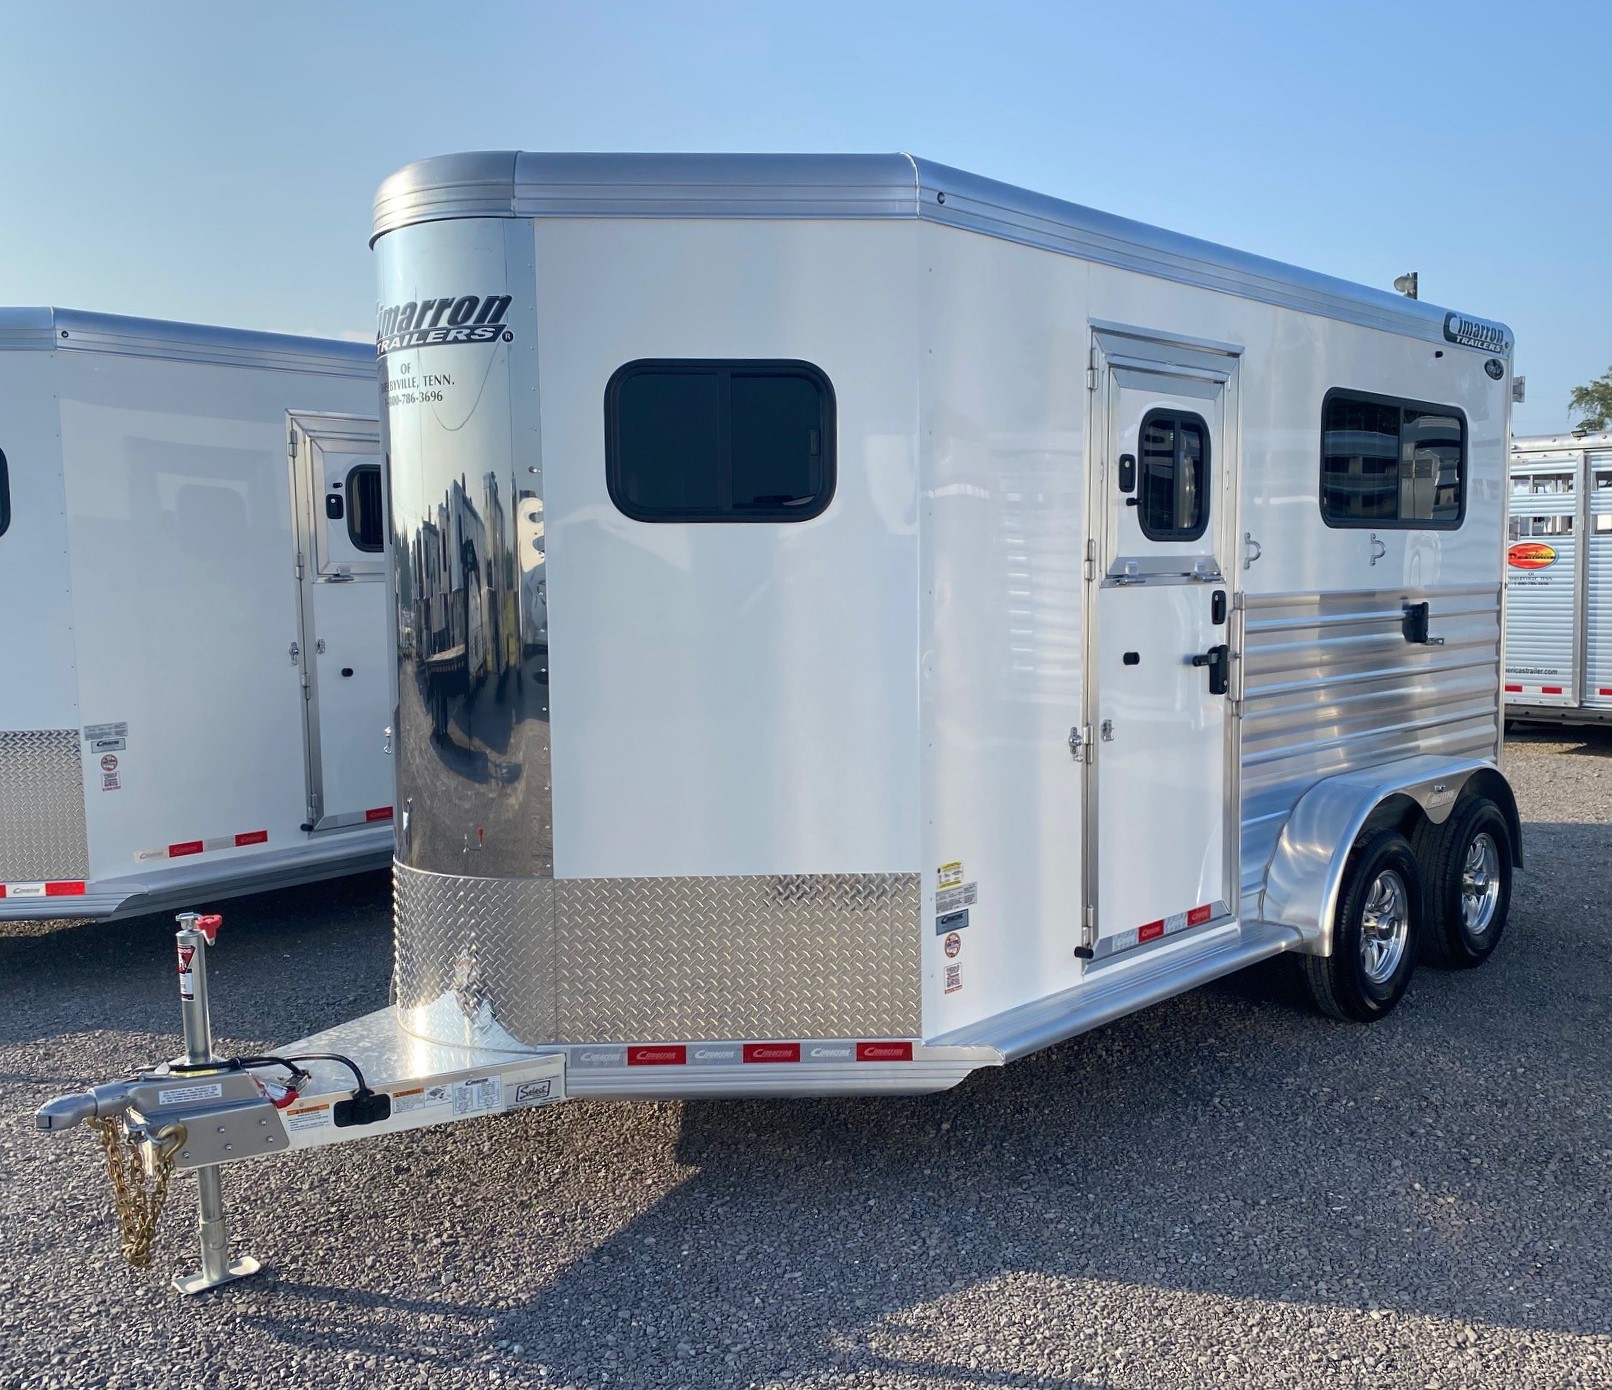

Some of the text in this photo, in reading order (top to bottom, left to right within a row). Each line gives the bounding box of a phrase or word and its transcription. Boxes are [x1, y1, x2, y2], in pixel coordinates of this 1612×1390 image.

[377, 295, 513, 339] imarron
[1443, 311, 1504, 344] Cimarron
[377, 327, 496, 355] TRAILERS
[1456, 336, 1501, 352] TRAILERS
[401, 363, 411, 375] OF
[423, 374, 455, 387] TENN.
[519, 1085, 548, 1099] Select
